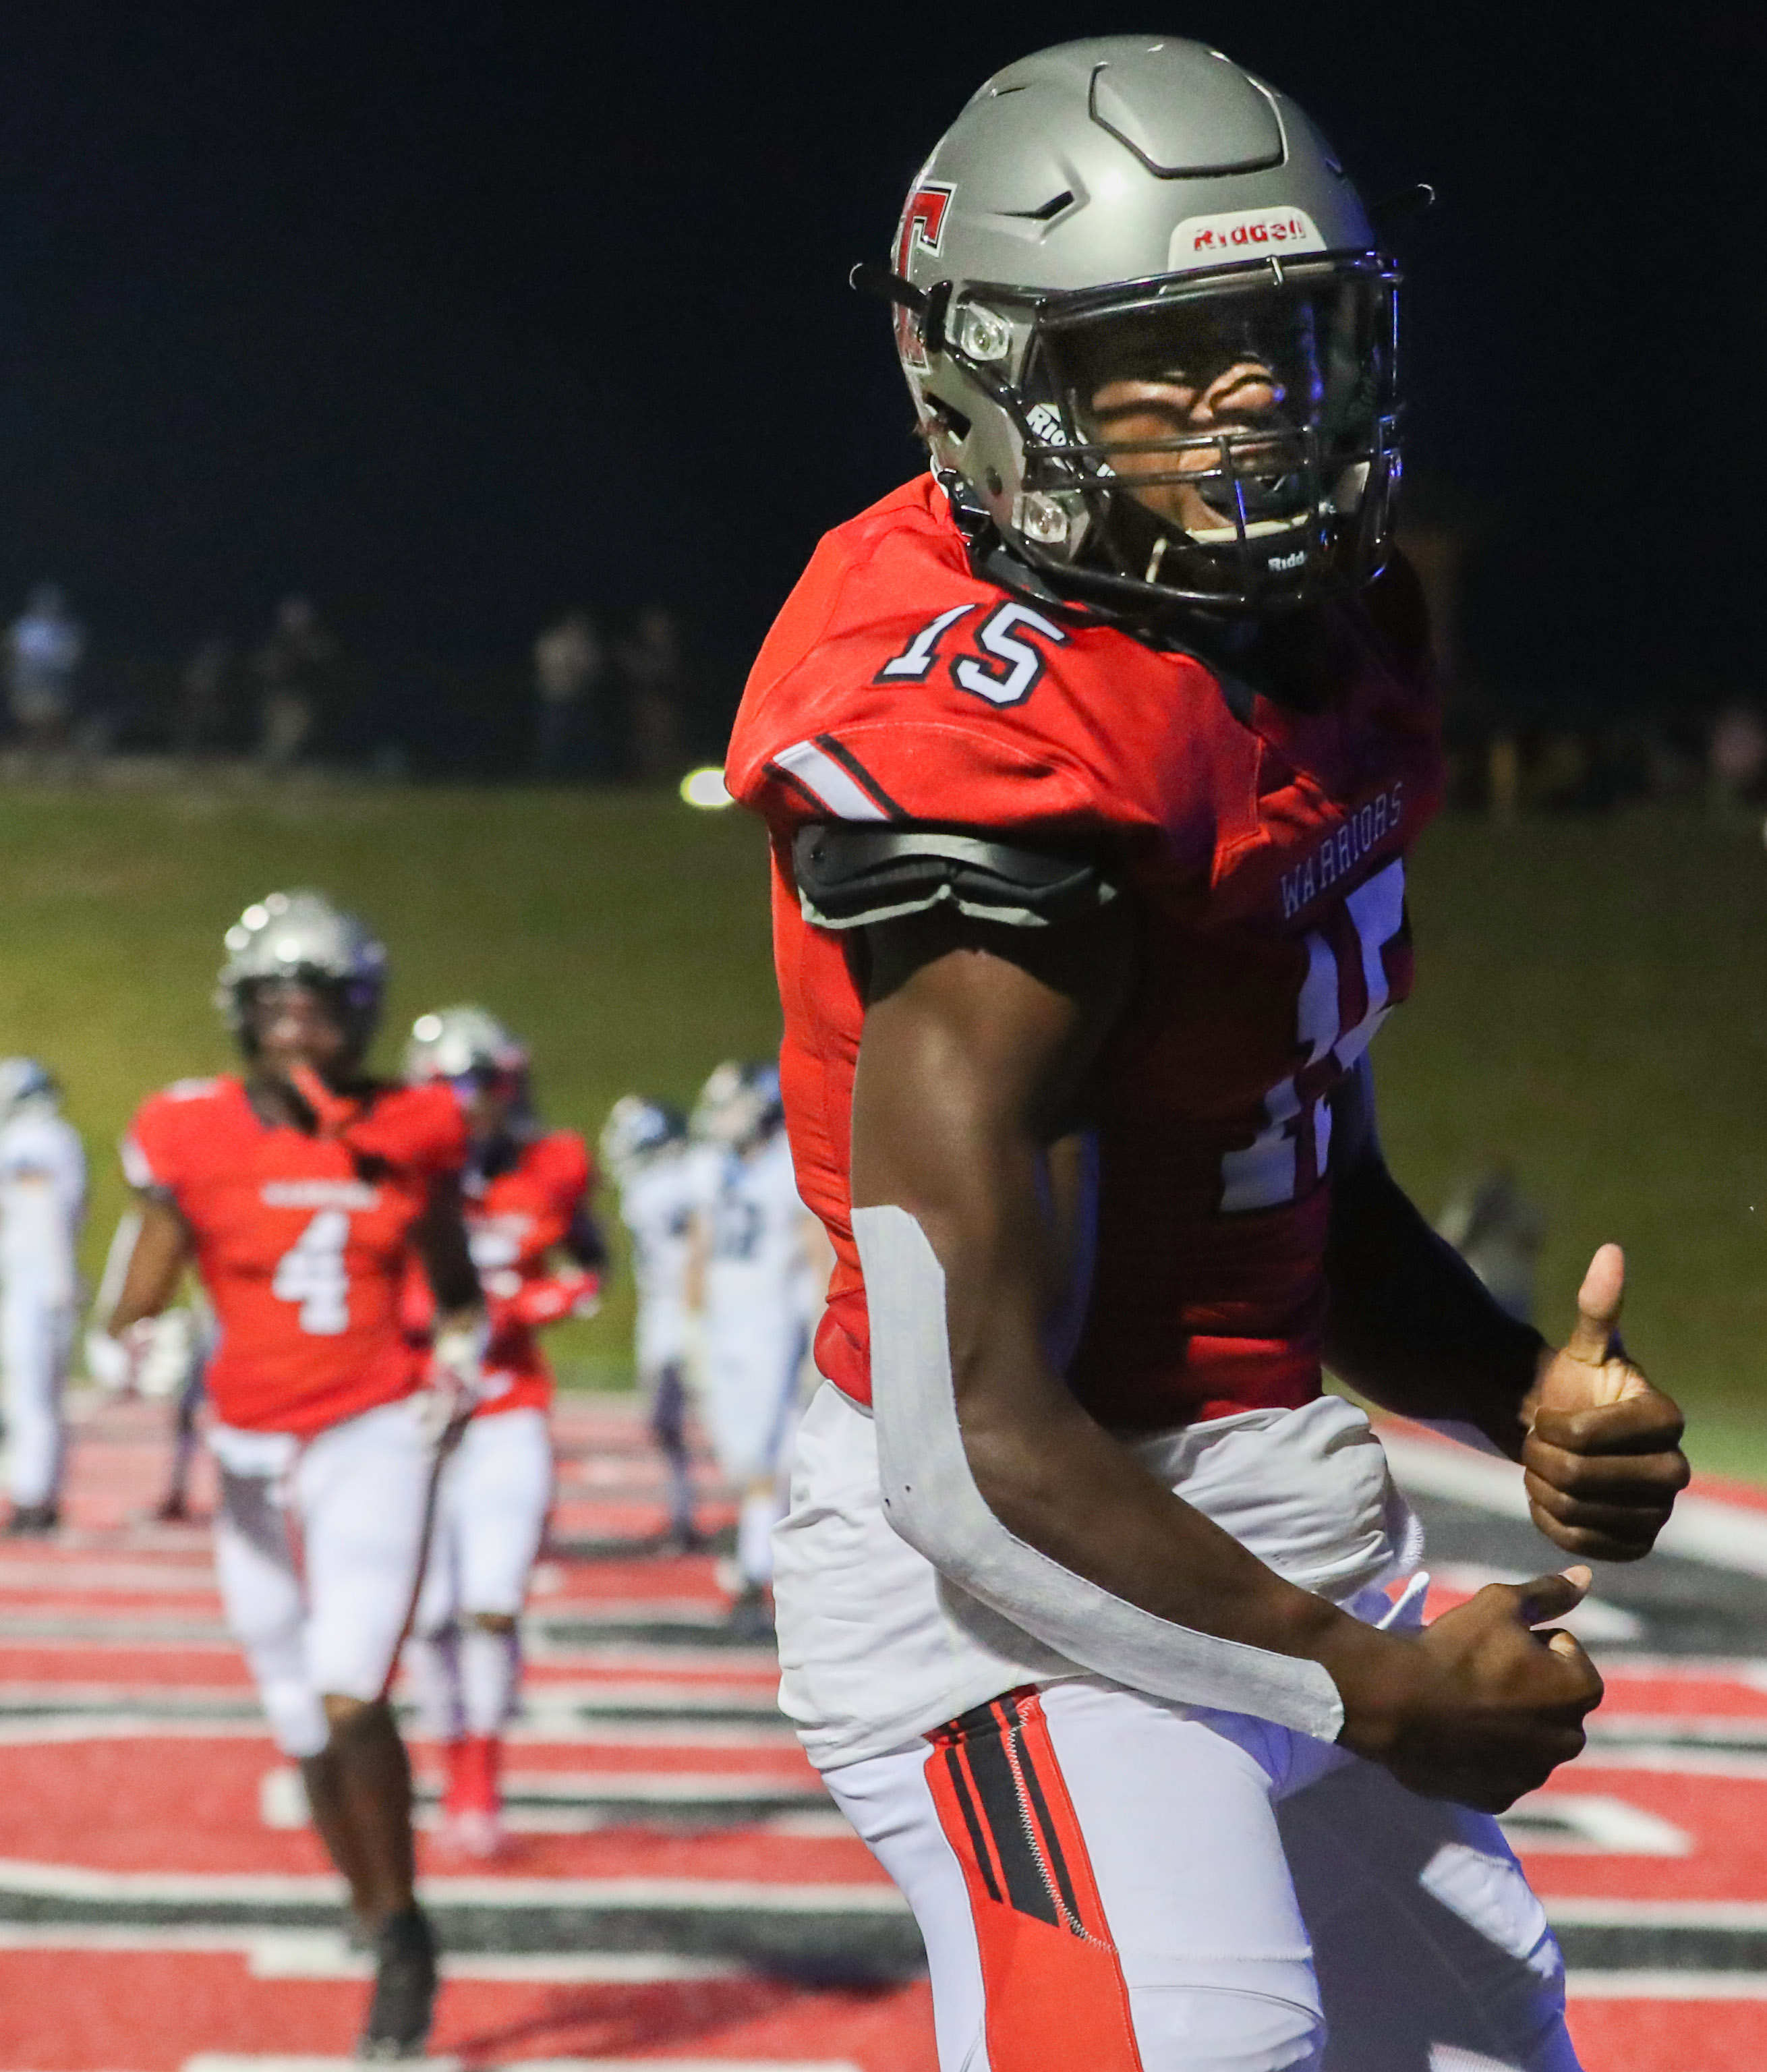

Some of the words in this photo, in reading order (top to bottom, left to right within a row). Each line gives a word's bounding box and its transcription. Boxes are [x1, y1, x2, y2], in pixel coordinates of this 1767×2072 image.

[1194, 217, 1307, 252] Riddell
[1268, 550, 1305, 571] Ridd
[873, 599, 1072, 710] 15
[1281, 781, 1403, 919] WARRIORS
[271, 1211, 351, 1335] 4
